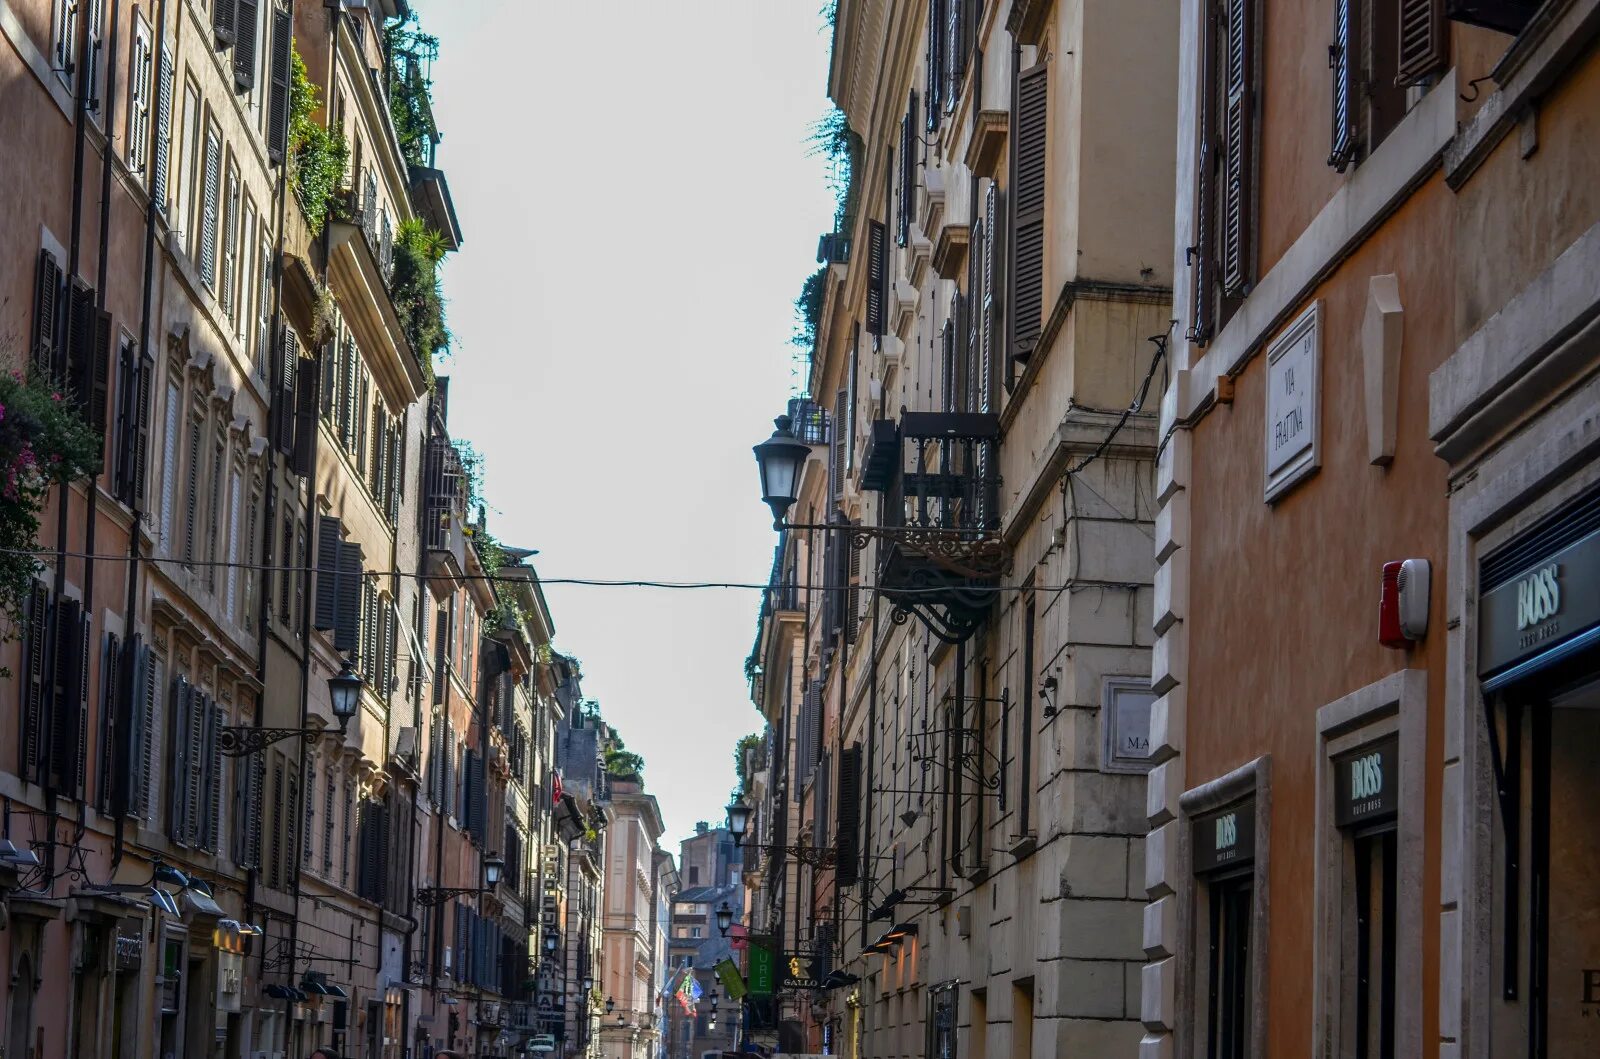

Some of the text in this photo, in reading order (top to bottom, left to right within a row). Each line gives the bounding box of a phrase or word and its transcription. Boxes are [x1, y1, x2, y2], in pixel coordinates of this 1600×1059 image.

[1284, 367, 1296, 396] VIA
[1275, 406, 1304, 451] FRATTINA
[1517, 563, 1559, 631] BOSS
[1128, 736, 1149, 750] MA
[1351, 752, 1382, 800] BOSS
[1215, 813, 1236, 850] BOSS
[783, 978, 818, 987] GALLO
